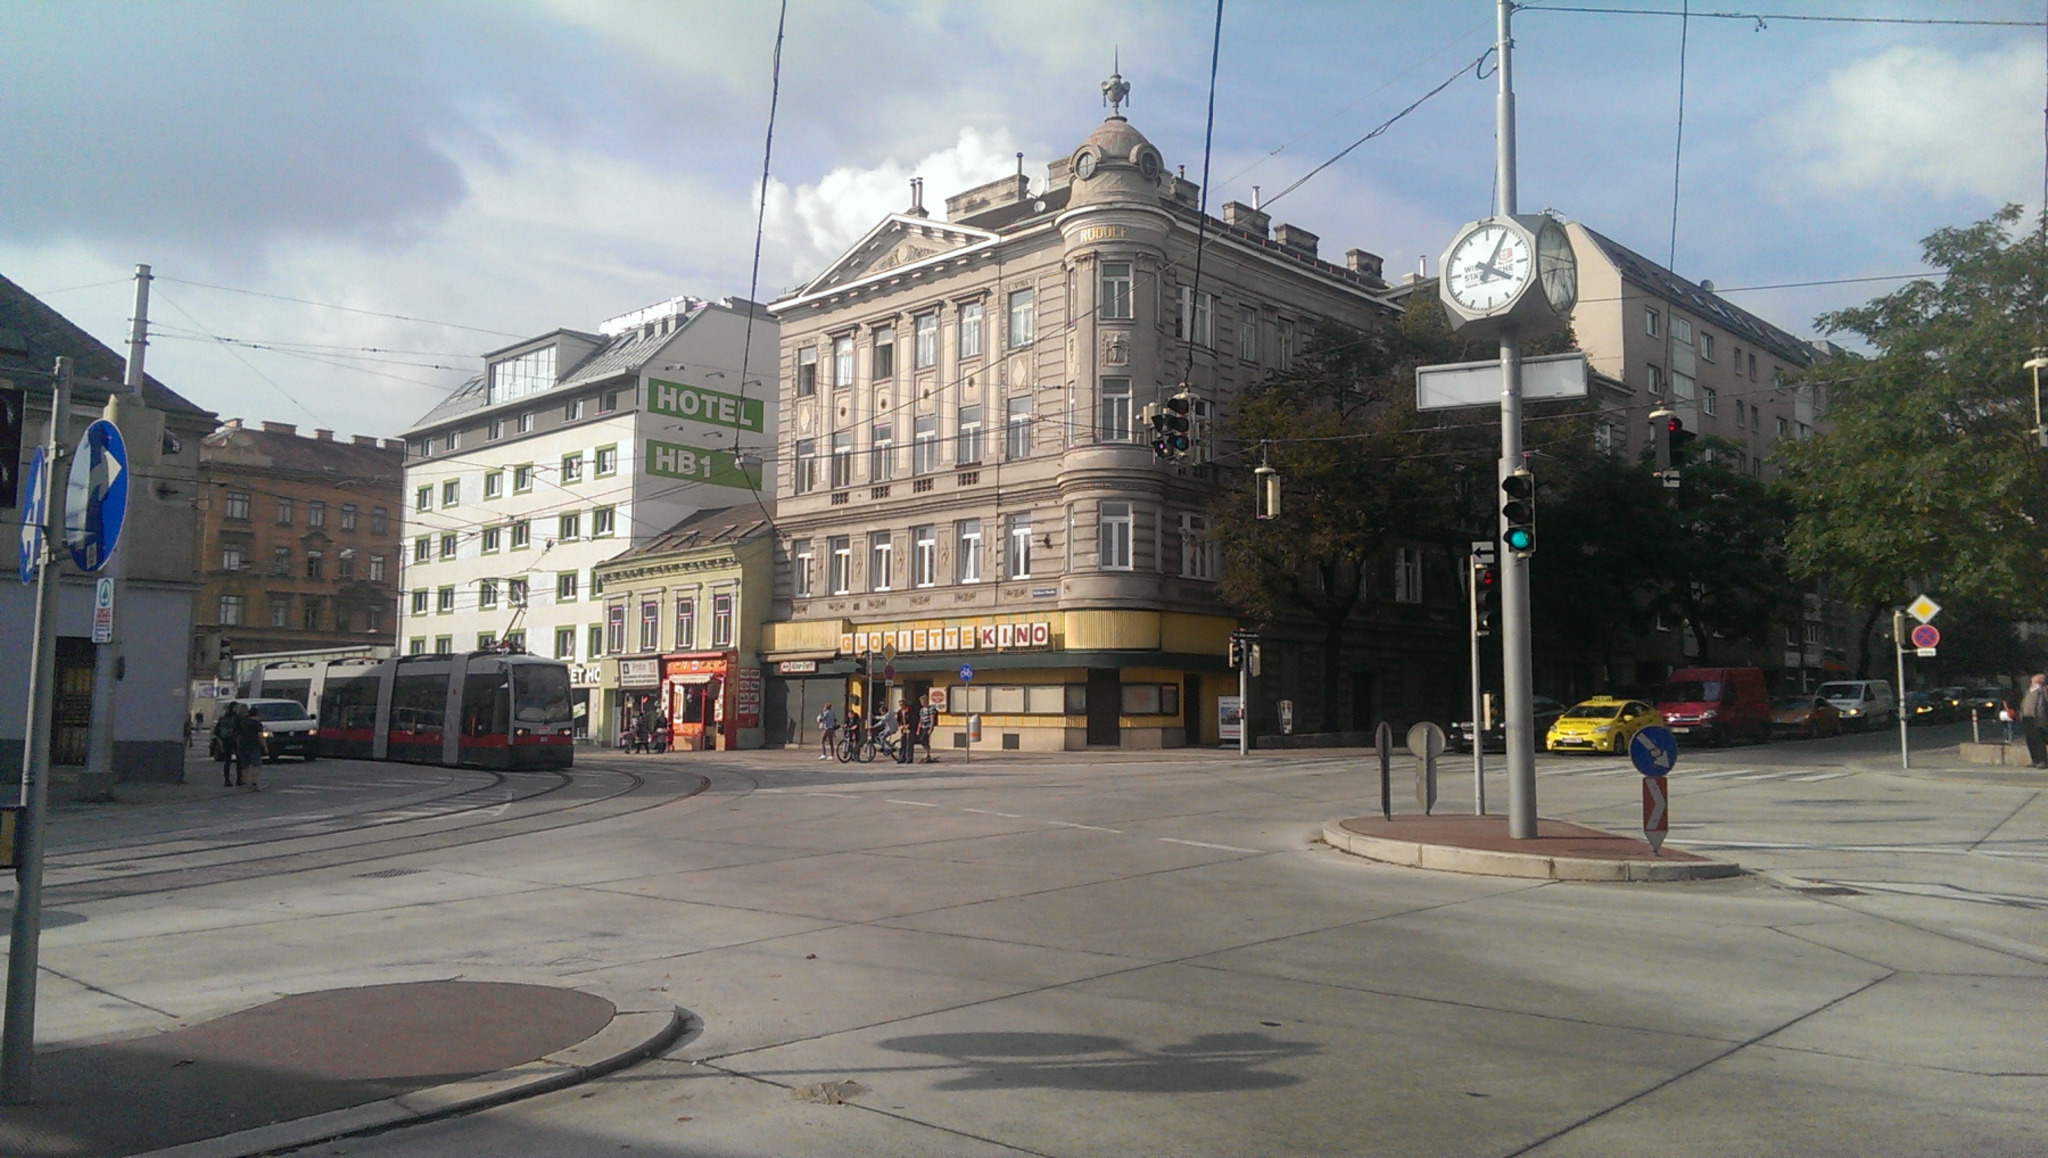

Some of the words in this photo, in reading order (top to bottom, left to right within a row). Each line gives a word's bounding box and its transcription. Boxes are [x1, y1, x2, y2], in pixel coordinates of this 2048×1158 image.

[657, 384, 752, 427] HOTEL
[656, 446, 711, 478] HB1
[842, 630, 972, 651] GLORIETTE
[982, 626, 1046, 645] KINO
